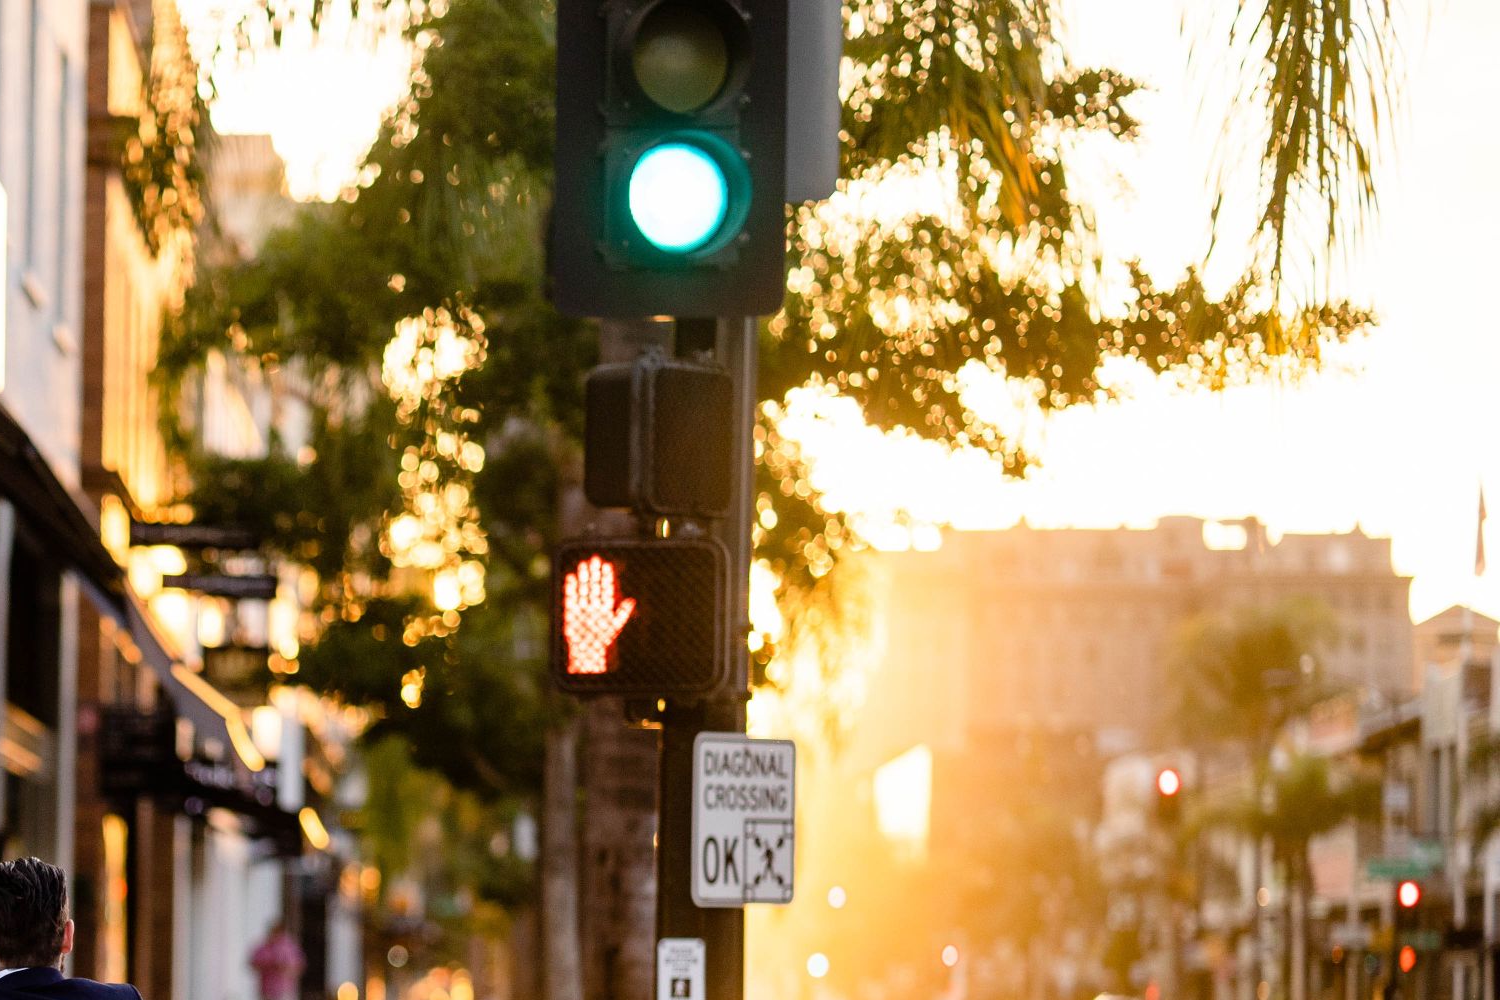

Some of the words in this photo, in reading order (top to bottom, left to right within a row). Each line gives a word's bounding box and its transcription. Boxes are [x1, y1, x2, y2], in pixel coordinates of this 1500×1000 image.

[703, 749, 788, 780] DIAGONAL
[703, 783, 788, 812] CROSSING
[703, 835, 740, 885] OK
